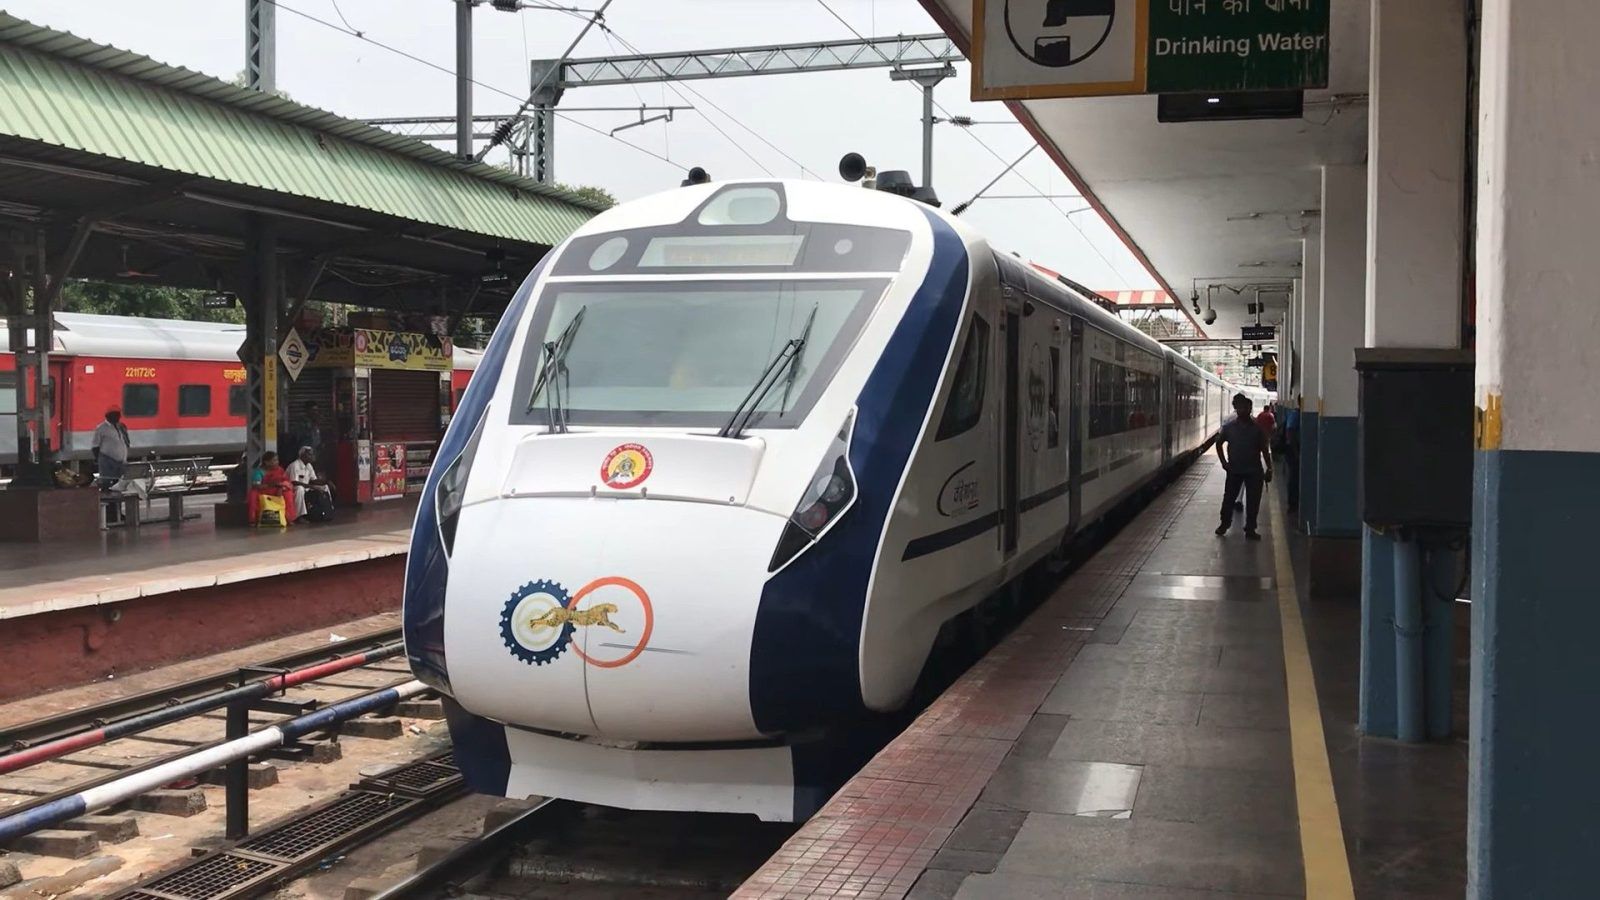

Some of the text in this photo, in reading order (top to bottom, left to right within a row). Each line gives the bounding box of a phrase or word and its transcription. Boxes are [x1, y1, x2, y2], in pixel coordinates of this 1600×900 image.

[1155, 32, 1324, 57] Drinking Water
[125, 367, 156, 378] 221172/C
